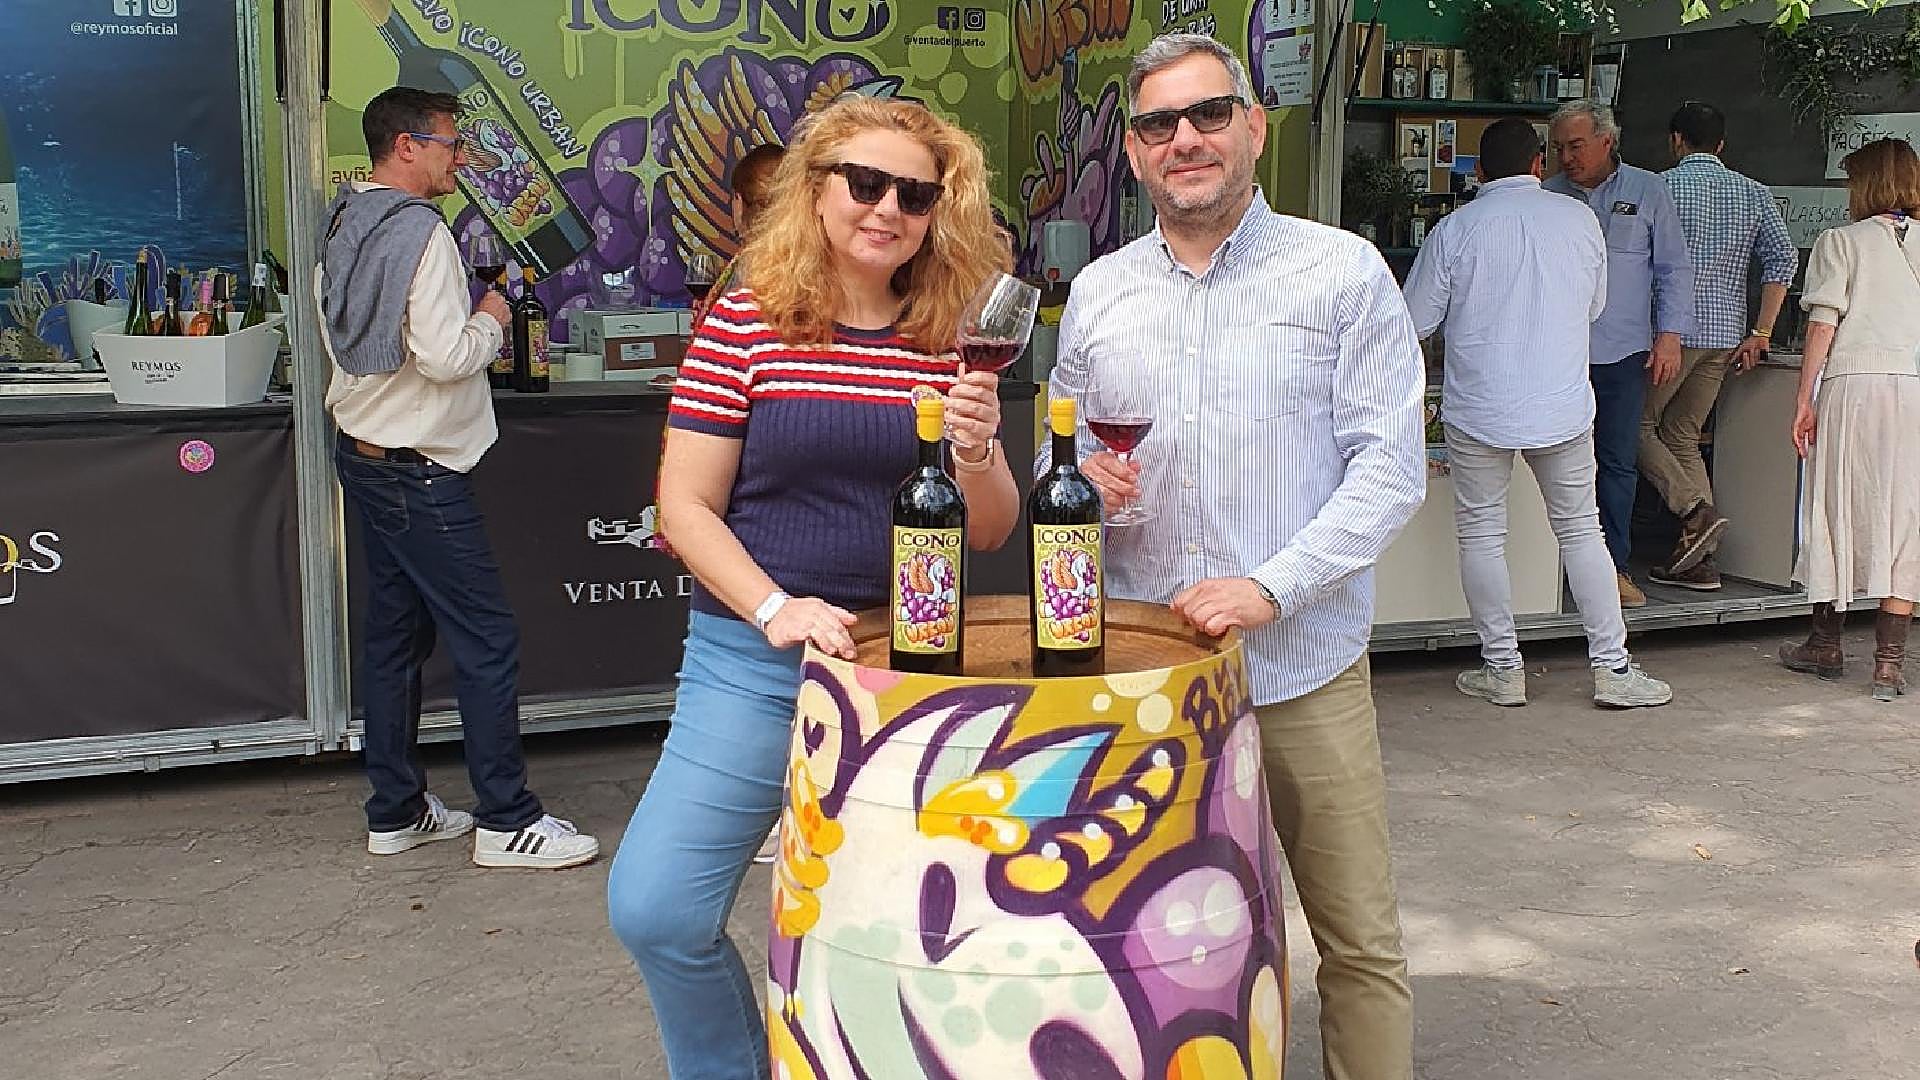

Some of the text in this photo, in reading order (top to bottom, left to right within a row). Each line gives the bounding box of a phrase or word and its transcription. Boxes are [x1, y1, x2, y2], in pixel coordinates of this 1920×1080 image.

[70, 22, 178, 36] @reymosoficial
[460, 21, 526, 77] ICONO
[520, 80, 586, 159] URBAN
[897, 530, 961, 549] ICONO
[1037, 528, 1101, 545] ICONO
[562, 580, 664, 604] VENTA
